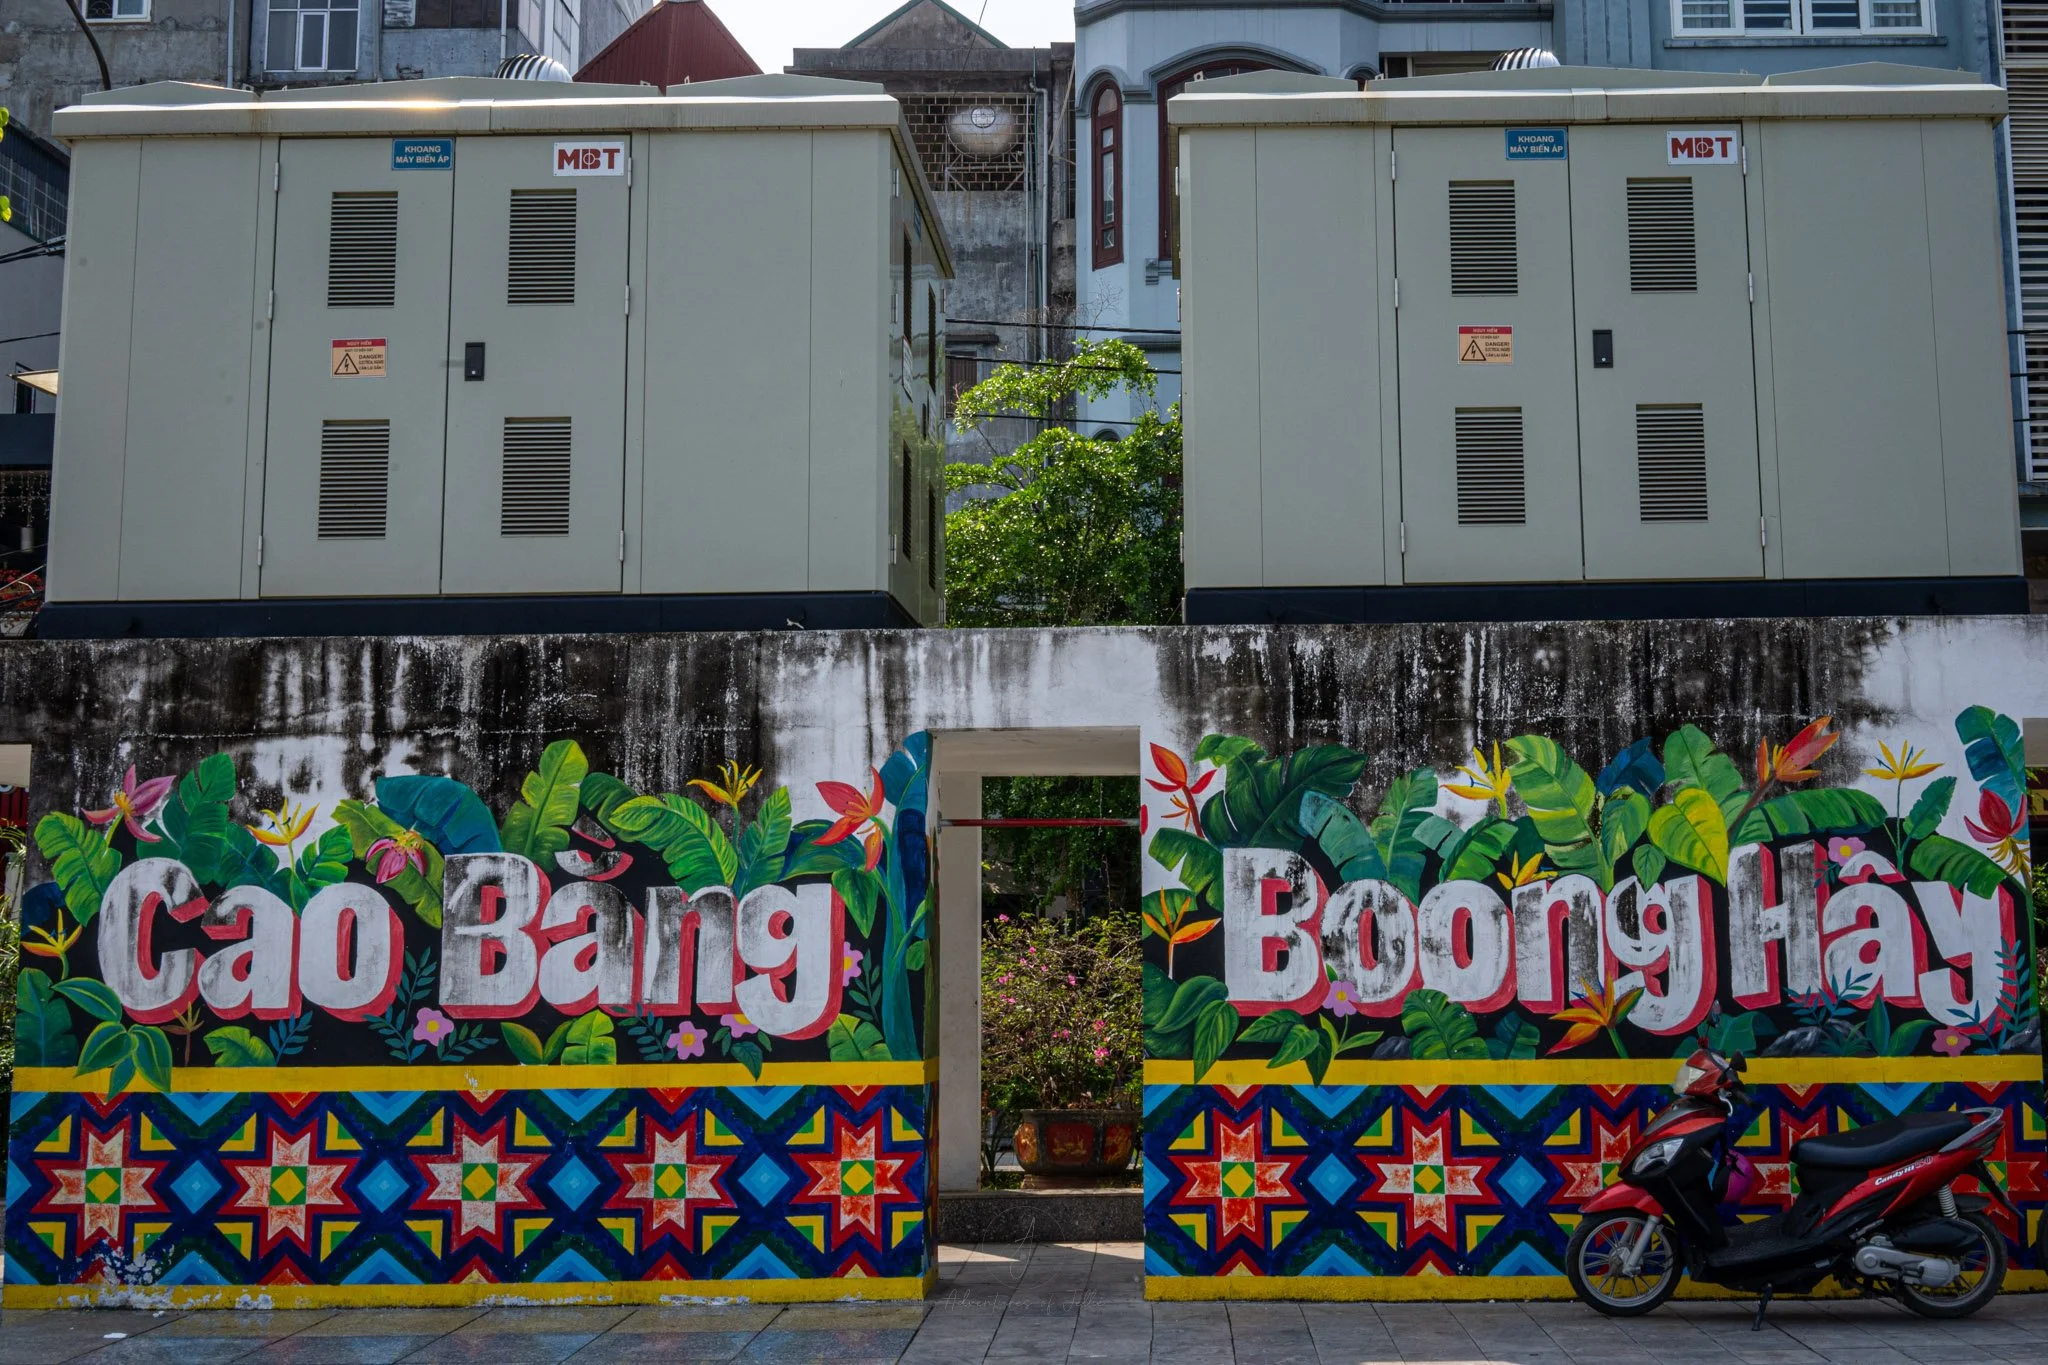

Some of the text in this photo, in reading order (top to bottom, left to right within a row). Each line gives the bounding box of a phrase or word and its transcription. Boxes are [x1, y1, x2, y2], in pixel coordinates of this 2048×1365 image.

[1518, 135, 1555, 143] KHOANG
[1671, 136, 1733, 158] MBT
[404, 145, 441, 154] KHOANG
[1510, 143, 1563, 153] MÁY BIẾN ÁP
[395, 153, 449, 163] MÁY BIẾN ÁP
[557, 148, 620, 170] MBT
[97, 818, 843, 1040] Cao Bằng
[1222, 839, 2015, 1037] Boong Hây
[1875, 1170, 1904, 1186] Candy
